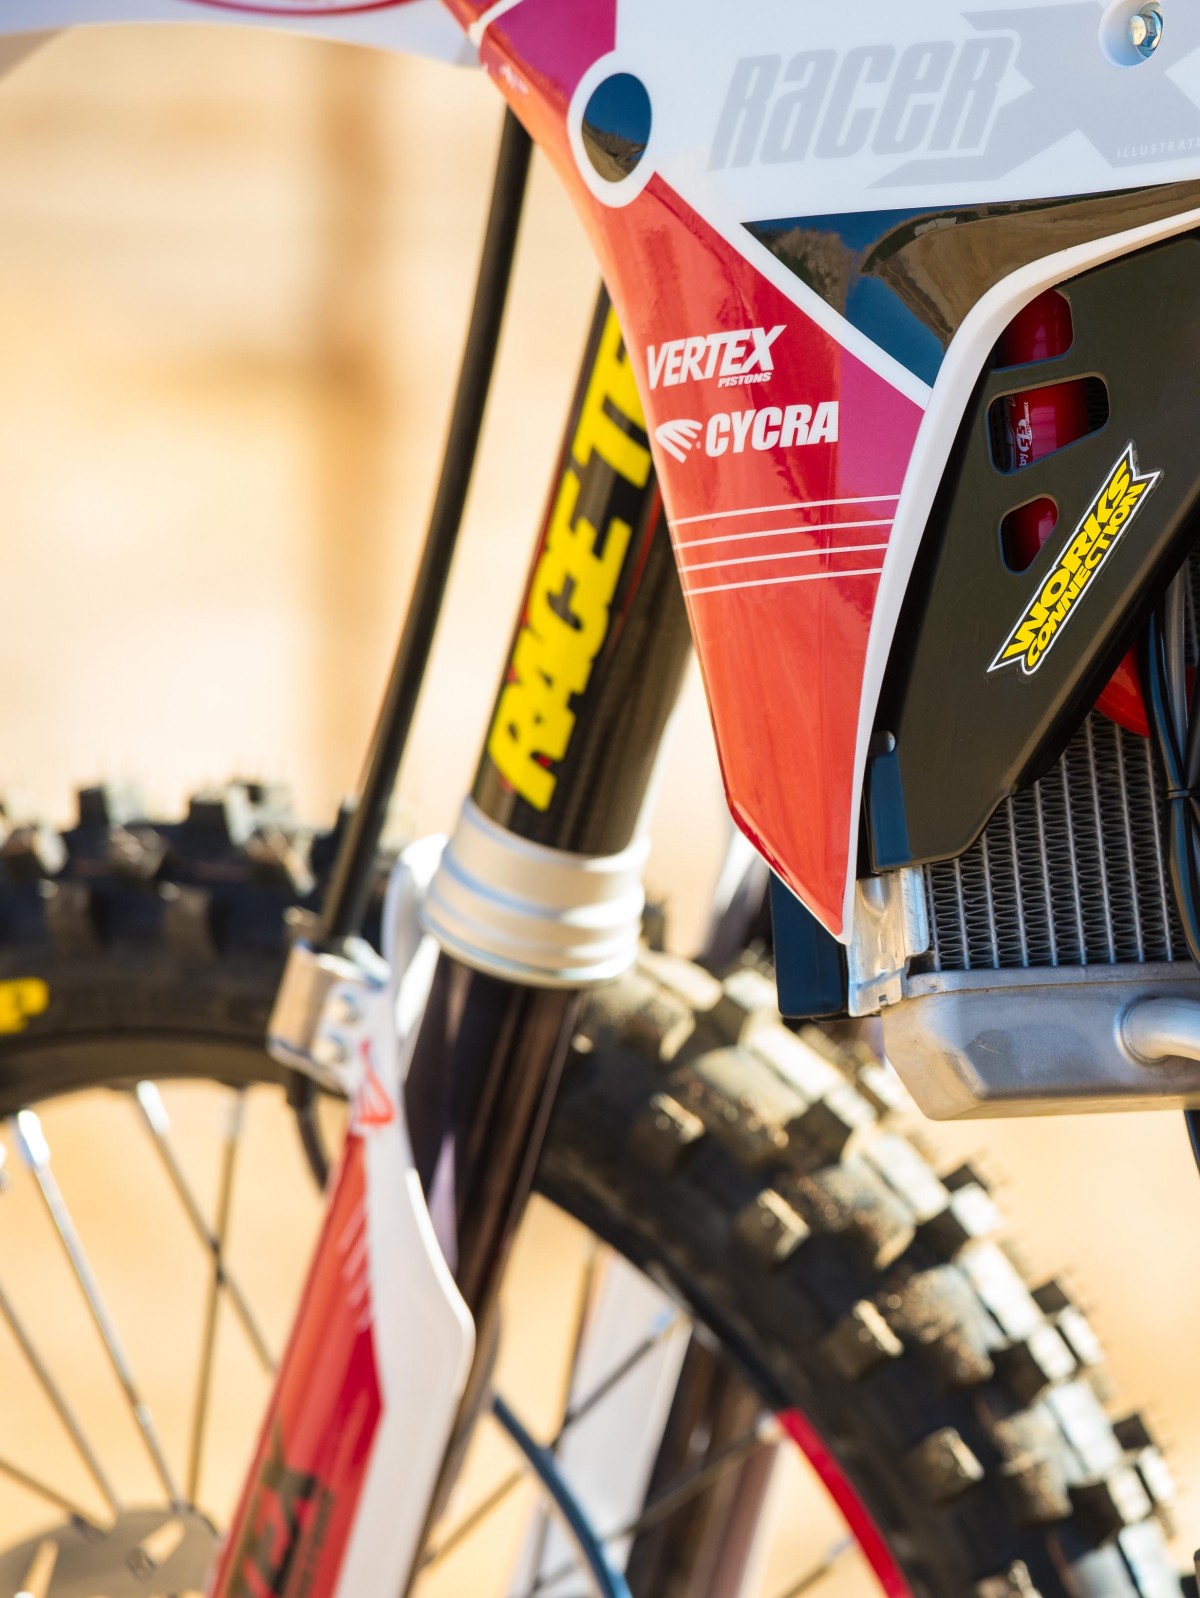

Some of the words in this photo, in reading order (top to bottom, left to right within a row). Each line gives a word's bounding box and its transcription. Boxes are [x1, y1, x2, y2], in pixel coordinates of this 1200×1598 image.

[706, 37, 1017, 171] RACER
[647, 324, 787, 391] VERTEX
[717, 372, 772, 388] PISTONS
[705, 401, 839, 457] CYCRA
[1002, 460, 1130, 659] WORKS
[1028, 482, 1147, 667] CONNECTION
